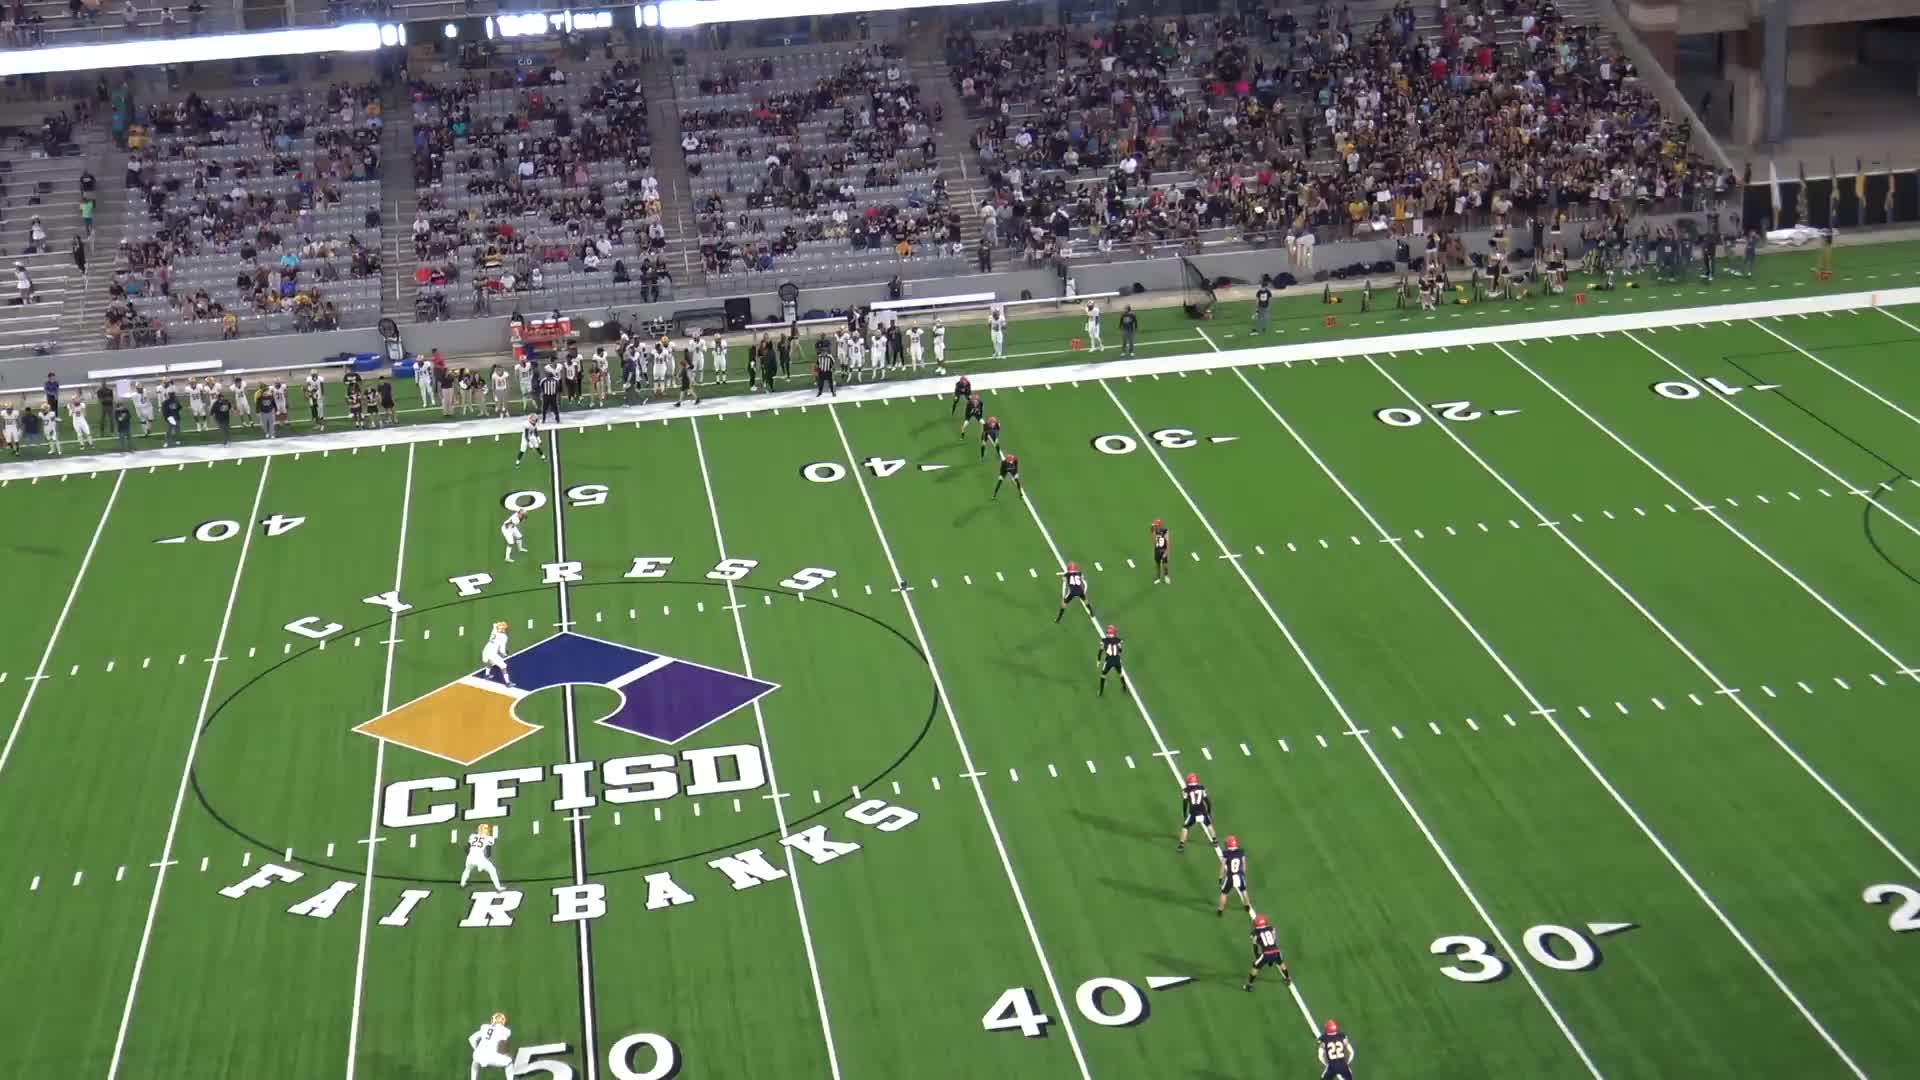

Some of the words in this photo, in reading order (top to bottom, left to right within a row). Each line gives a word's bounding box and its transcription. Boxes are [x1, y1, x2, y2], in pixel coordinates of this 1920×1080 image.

[1653, 377, 1743, 400] 10
[1377, 401, 1482, 427] 20
[1094, 429, 1198, 455] 30
[803, 457, 906, 483] 40
[504, 484, 609, 513] 50
[195, 515, 305, 542] 40
[286, 556, 836, 639] CYPRESS
[382, 743, 768, 829] CFISD
[1189, 789, 1203, 805] 17
[471, 836, 484, 848] 25
[217, 799, 920, 928] FAIRBANKS
[1430, 924, 1595, 982] 30
[982, 977, 1143, 1037] 40
[485, 1028, 494, 1041] 9
[513, 1033, 675, 1080] 50
[1327, 1041, 1345, 1060] 22
